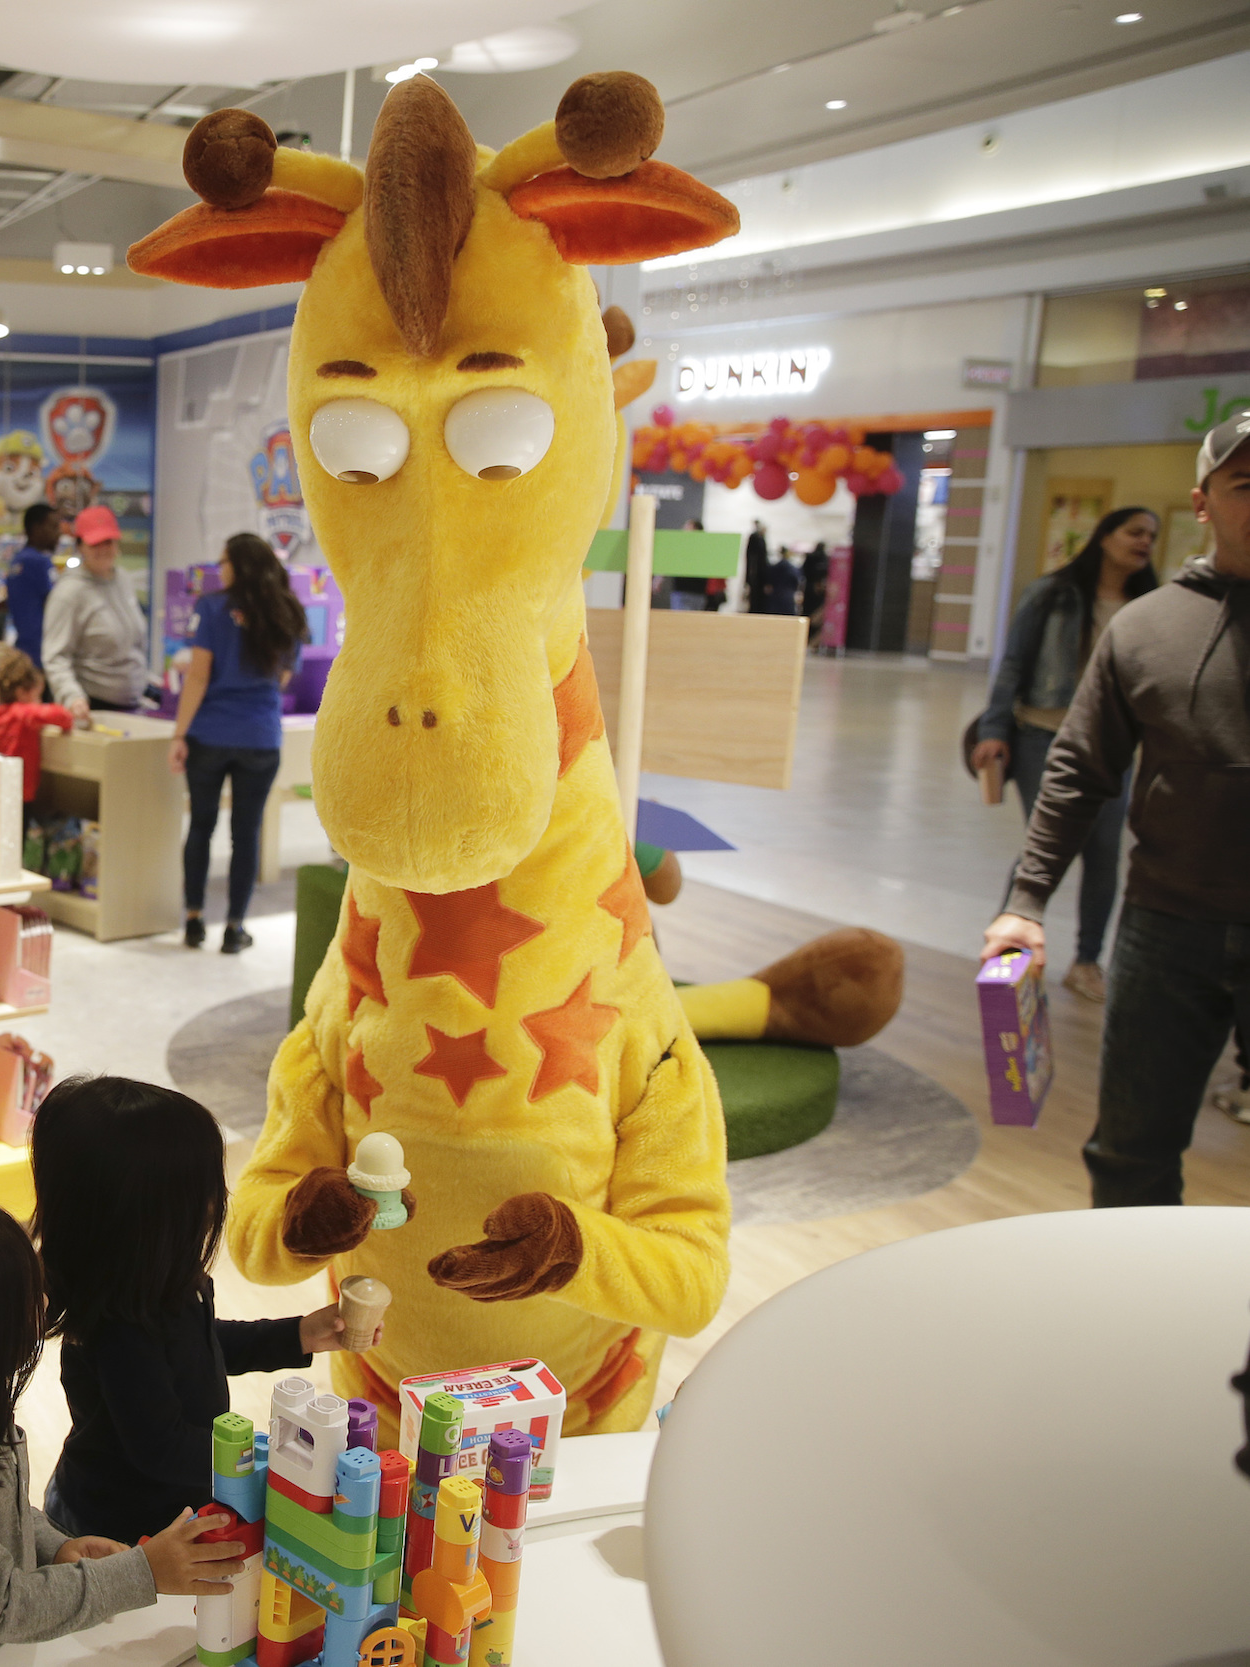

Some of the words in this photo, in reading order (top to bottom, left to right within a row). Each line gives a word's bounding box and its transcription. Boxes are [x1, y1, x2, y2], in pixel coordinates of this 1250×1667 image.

[444, 1380, 493, 1392] CREAM
[492, 1375, 517, 1385] ICE
[438, 1458, 451, 1477] L
[459, 1453, 478, 1469] CE
[459, 1513, 476, 1533] V
[452, 1633, 465, 1650] T
